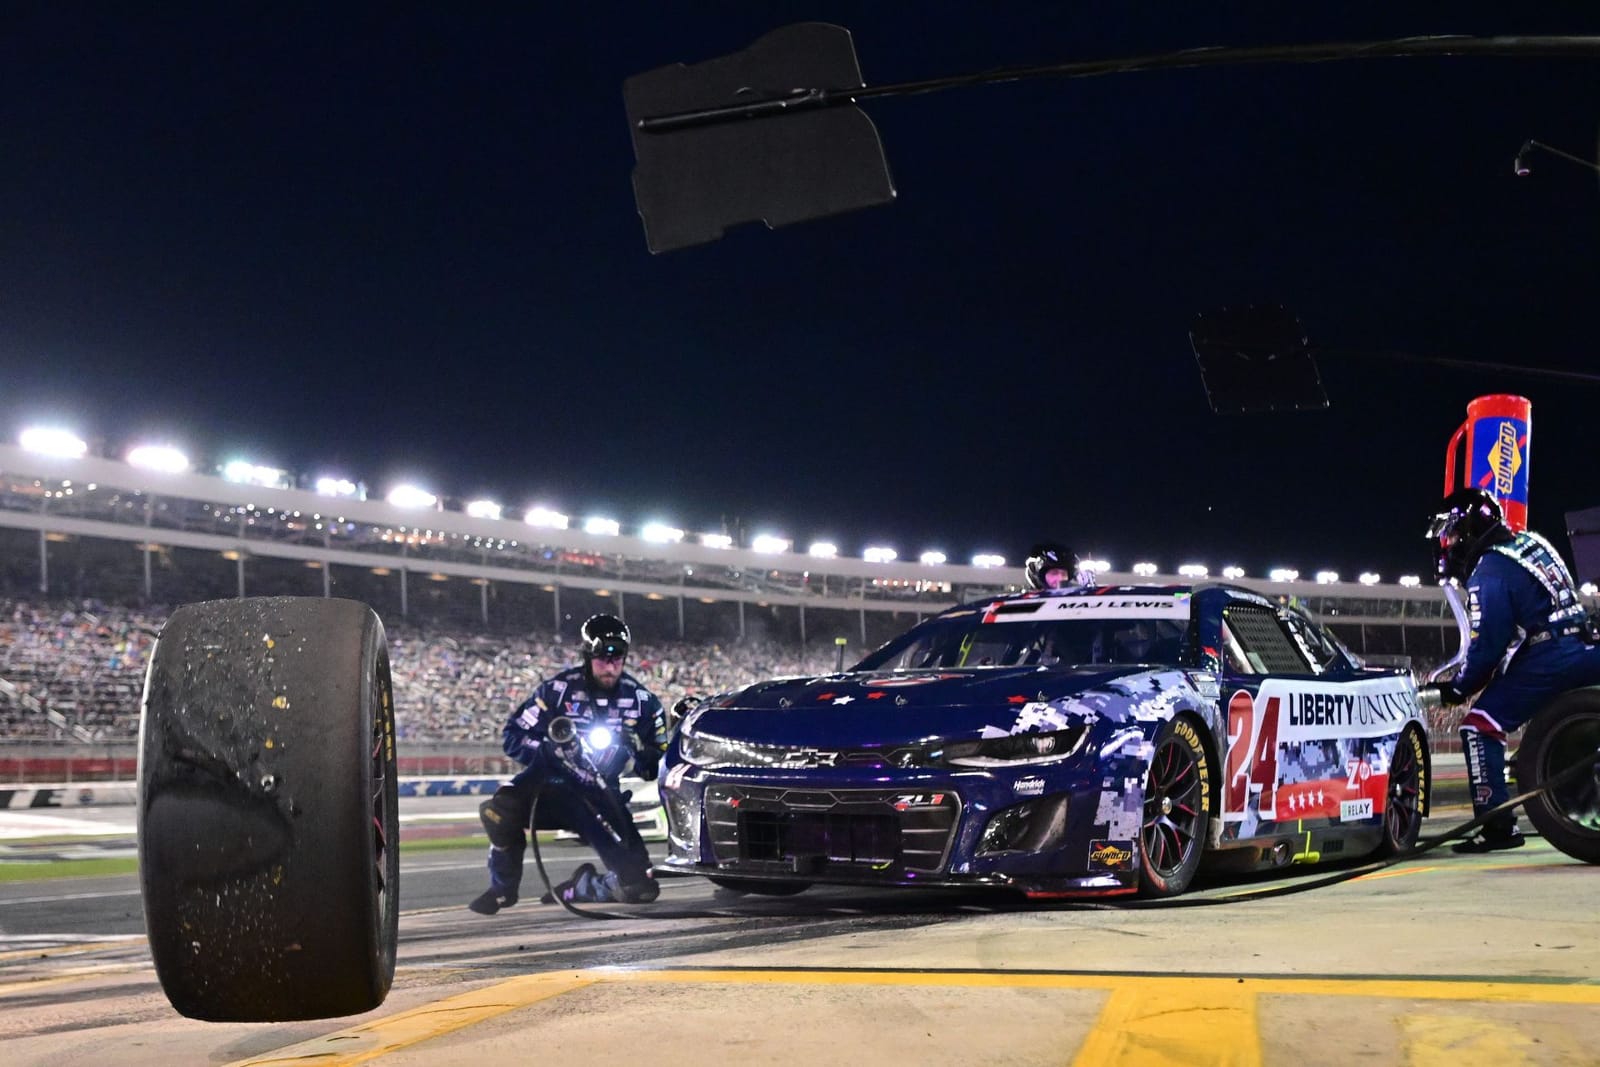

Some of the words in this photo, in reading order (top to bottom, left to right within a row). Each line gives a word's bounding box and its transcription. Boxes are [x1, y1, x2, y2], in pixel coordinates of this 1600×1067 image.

[1497, 423, 1516, 493] SUNOCO
[1057, 601, 1103, 610] MAJ
[1107, 600, 1175, 609] LEWIS
[1288, 691, 1355, 726] LIBERTY
[1174, 720, 1210, 812] GOODYEAR
[1223, 689, 1282, 822] 24
[1466, 732, 1482, 784] LIBERTY
[896, 793, 944, 806] ZL1
[1347, 803, 1370, 817] RELAY
[1090, 850, 1132, 862] SUNOCO
